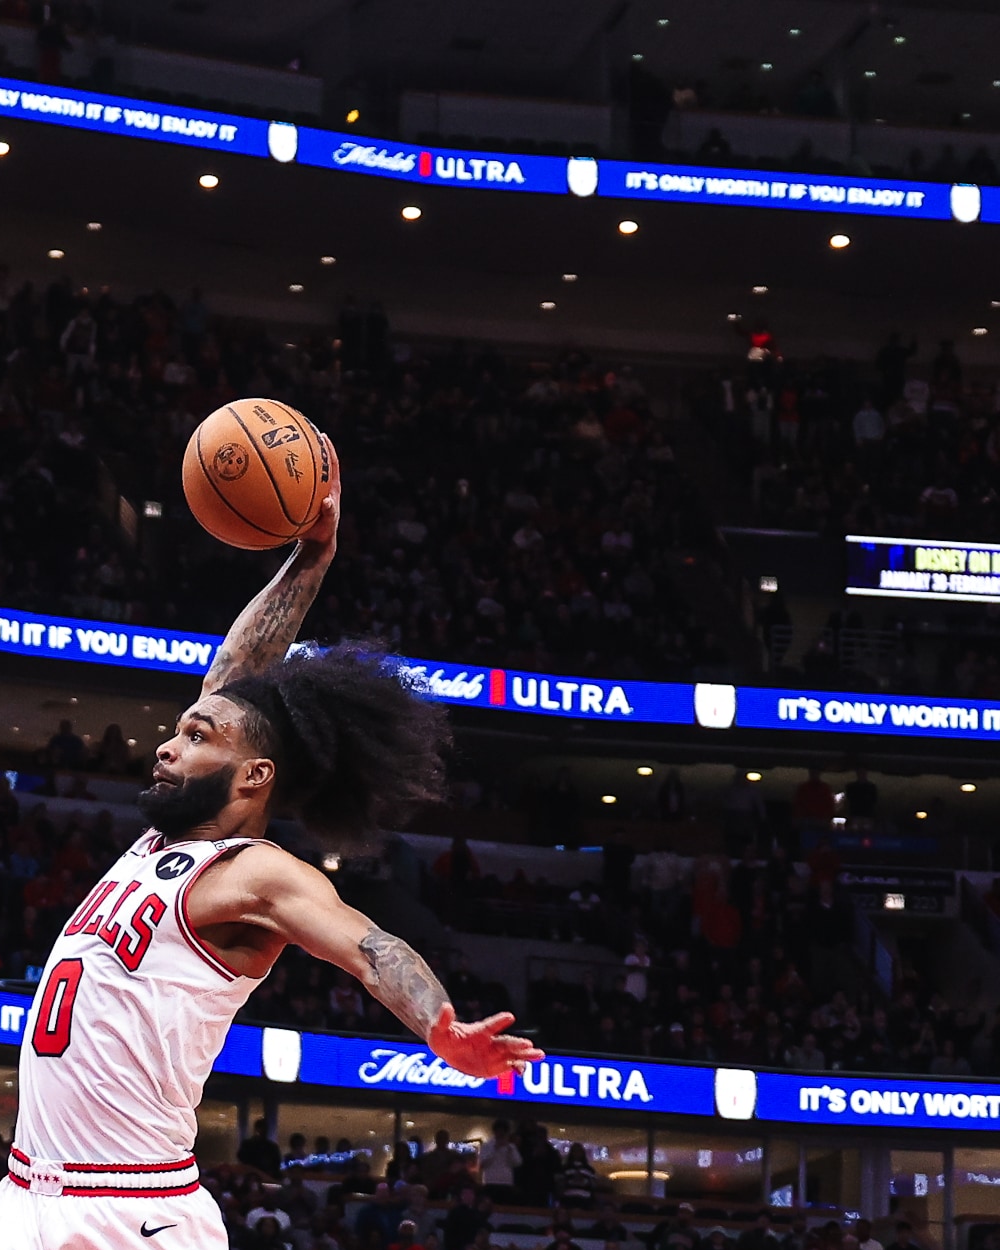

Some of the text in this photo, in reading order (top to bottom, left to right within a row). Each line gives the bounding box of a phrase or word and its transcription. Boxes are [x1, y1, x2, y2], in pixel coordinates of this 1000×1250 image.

[21, 92, 84, 118] WORTH
[86, 103, 105, 120] IT
[105, 105, 123, 123] IF
[124, 109, 160, 130] YOU
[161, 115, 218, 139] ENJOY
[219, 124, 238, 142] IT
[333, 142, 526, 184] Michelob ULTRA
[626, 171, 925, 208] IT'S ONLY WORTH IT IF YOU ENJOY IT
[915, 547, 967, 572] DISNEY
[22, 622, 46, 646] IT
[48, 625, 73, 649] IF
[76, 627, 128, 657] YOU
[131, 635, 212, 666] ENJOY
[512, 677, 634, 714] ULTRA
[778, 697, 1000, 731] IT'S ONLY WORTH IT
[64, 880, 167, 972] ULLS
[0, 1004, 25, 1032] IT
[31, 957, 84, 1057] 0
[522, 1061, 654, 1102] ULTRA
[799, 1084, 847, 1113] IT'S
[850, 1089, 920, 1115] ONLY
